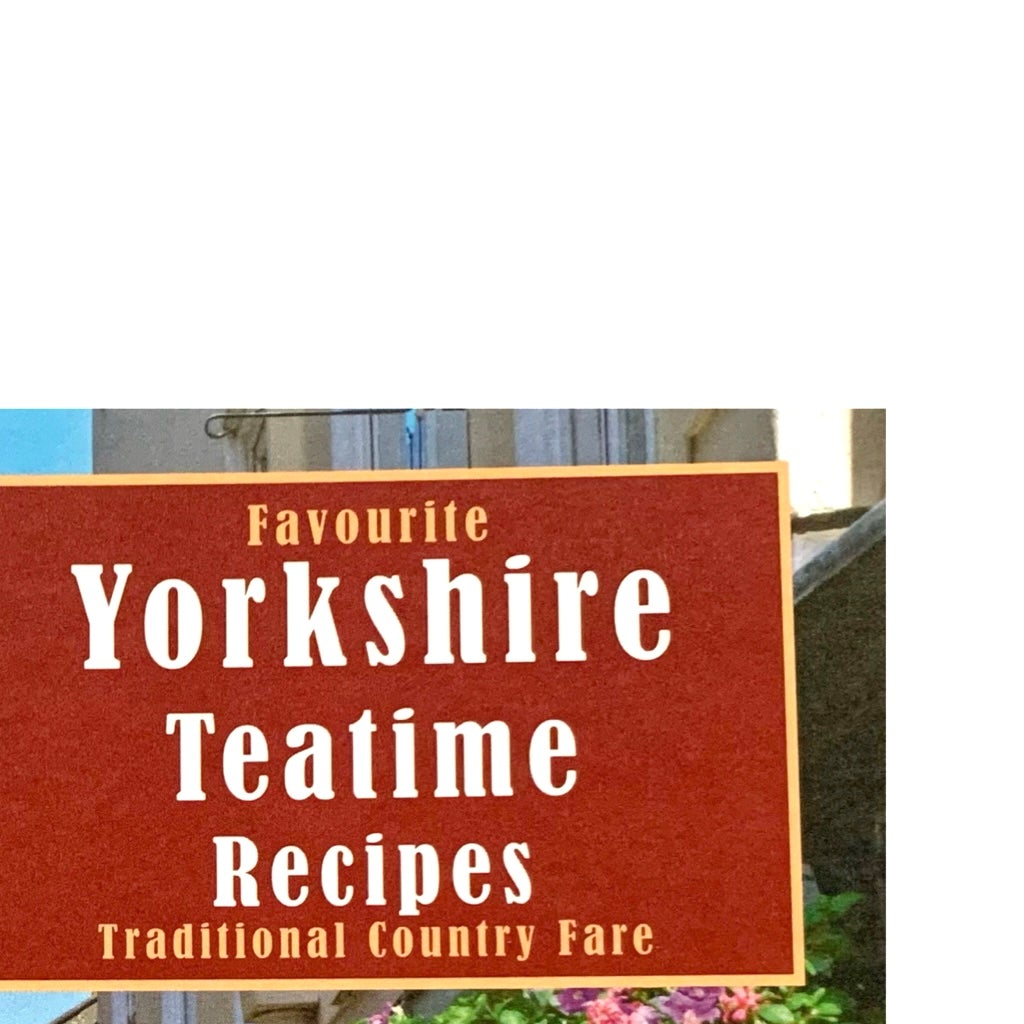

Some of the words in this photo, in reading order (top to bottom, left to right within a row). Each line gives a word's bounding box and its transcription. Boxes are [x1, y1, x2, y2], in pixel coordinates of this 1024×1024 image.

[247, 500, 488, 546] Favourite
[70, 554, 672, 670] Yorkshire
[165, 707, 578, 802] Teatime
[212, 832, 532, 917] Recipes
[97, 922, 346, 960] Traditional
[368, 920, 535, 962] Country
[558, 919, 653, 956] Fare
